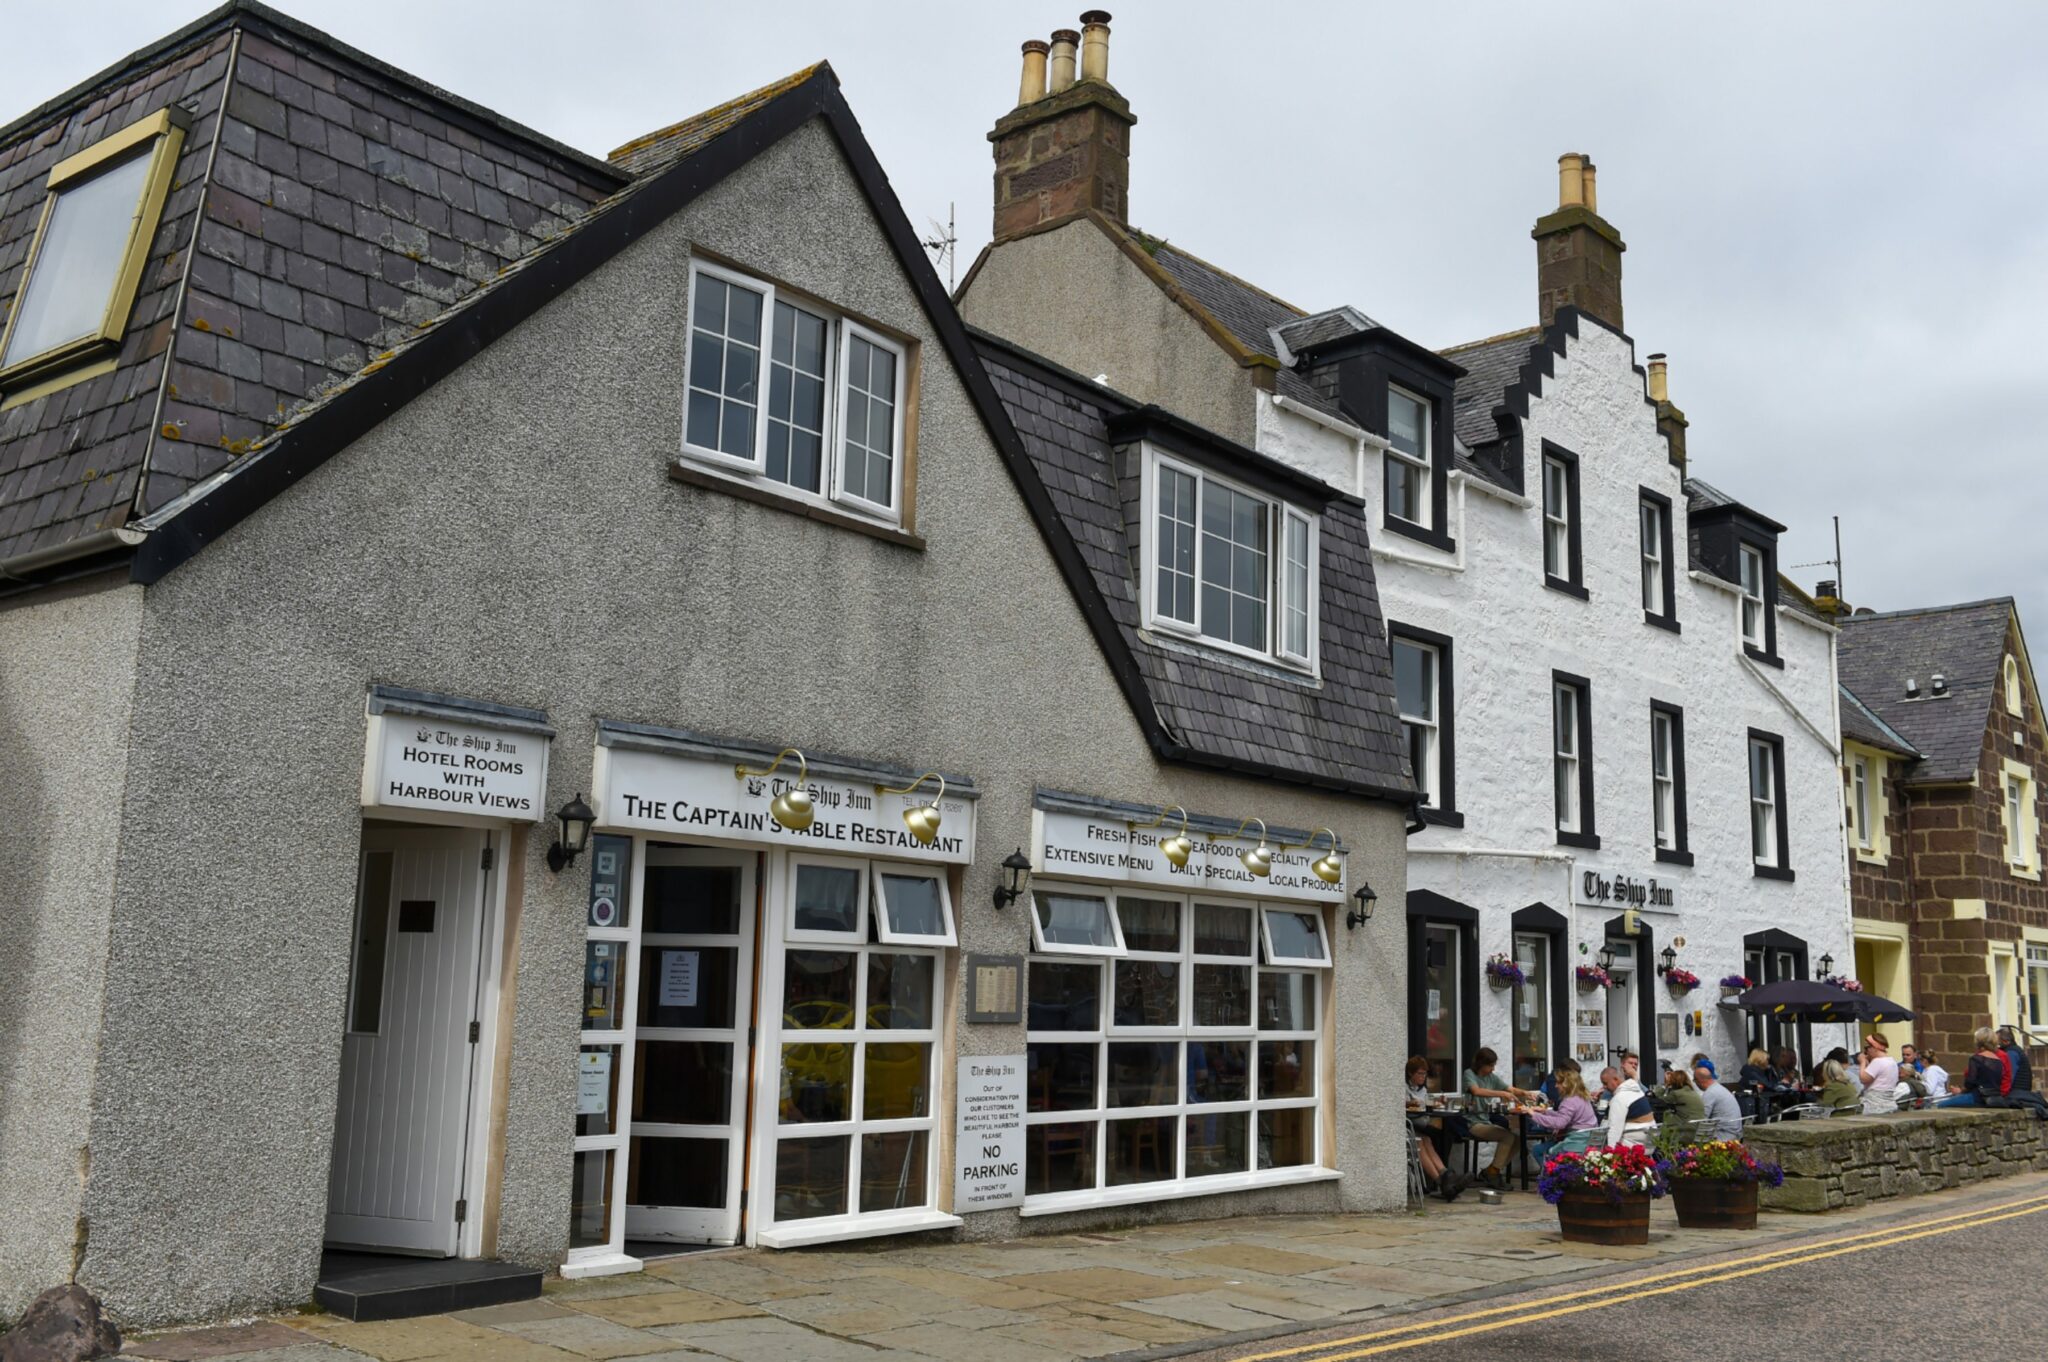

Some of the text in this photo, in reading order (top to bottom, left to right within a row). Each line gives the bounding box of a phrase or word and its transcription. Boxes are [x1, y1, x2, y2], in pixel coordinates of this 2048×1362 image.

[435, 730, 516, 754] The Ship Inn
[403, 746, 523, 775] HOTEL ROOMS
[443, 771, 484, 788] WITH
[390, 781, 530, 810] HARBOUR VIEWS
[807, 783, 840, 809] Ship
[846, 788, 871, 810] Inn
[623, 794, 667, 820] THE
[672, 800, 782, 833] CAPTAIN'S
[791, 819, 846, 841] ABLE
[1087, 824, 1127, 844] FRESH
[1130, 831, 1156, 848] FISH
[1189, 838, 1233, 858] EAFOOD
[1270, 852, 1310, 868] ECIALITY
[1045, 845, 1115, 867] EXTENSIVE
[1118, 853, 1154, 872] MENU
[1205, 864, 1255, 883] SPECIALS
[1269, 872, 1299, 889] LOCAL
[1583, 870, 1674, 907] The Ship Inn
[970, 1065, 1015, 1077] The Ship Inn
[965, 1094, 1008, 1103] CONSIDERATION
[964, 1121, 1019, 1132] BEAUTIFUL HARBOUR
[982, 1132, 1002, 1140] PLEASE
[982, 1145, 1001, 1158] NO
[963, 1163, 1018, 1180] PARKING
[981, 1184, 999, 1192] FRONT
[968, 1192, 1013, 1203] THESE WINDOWS
